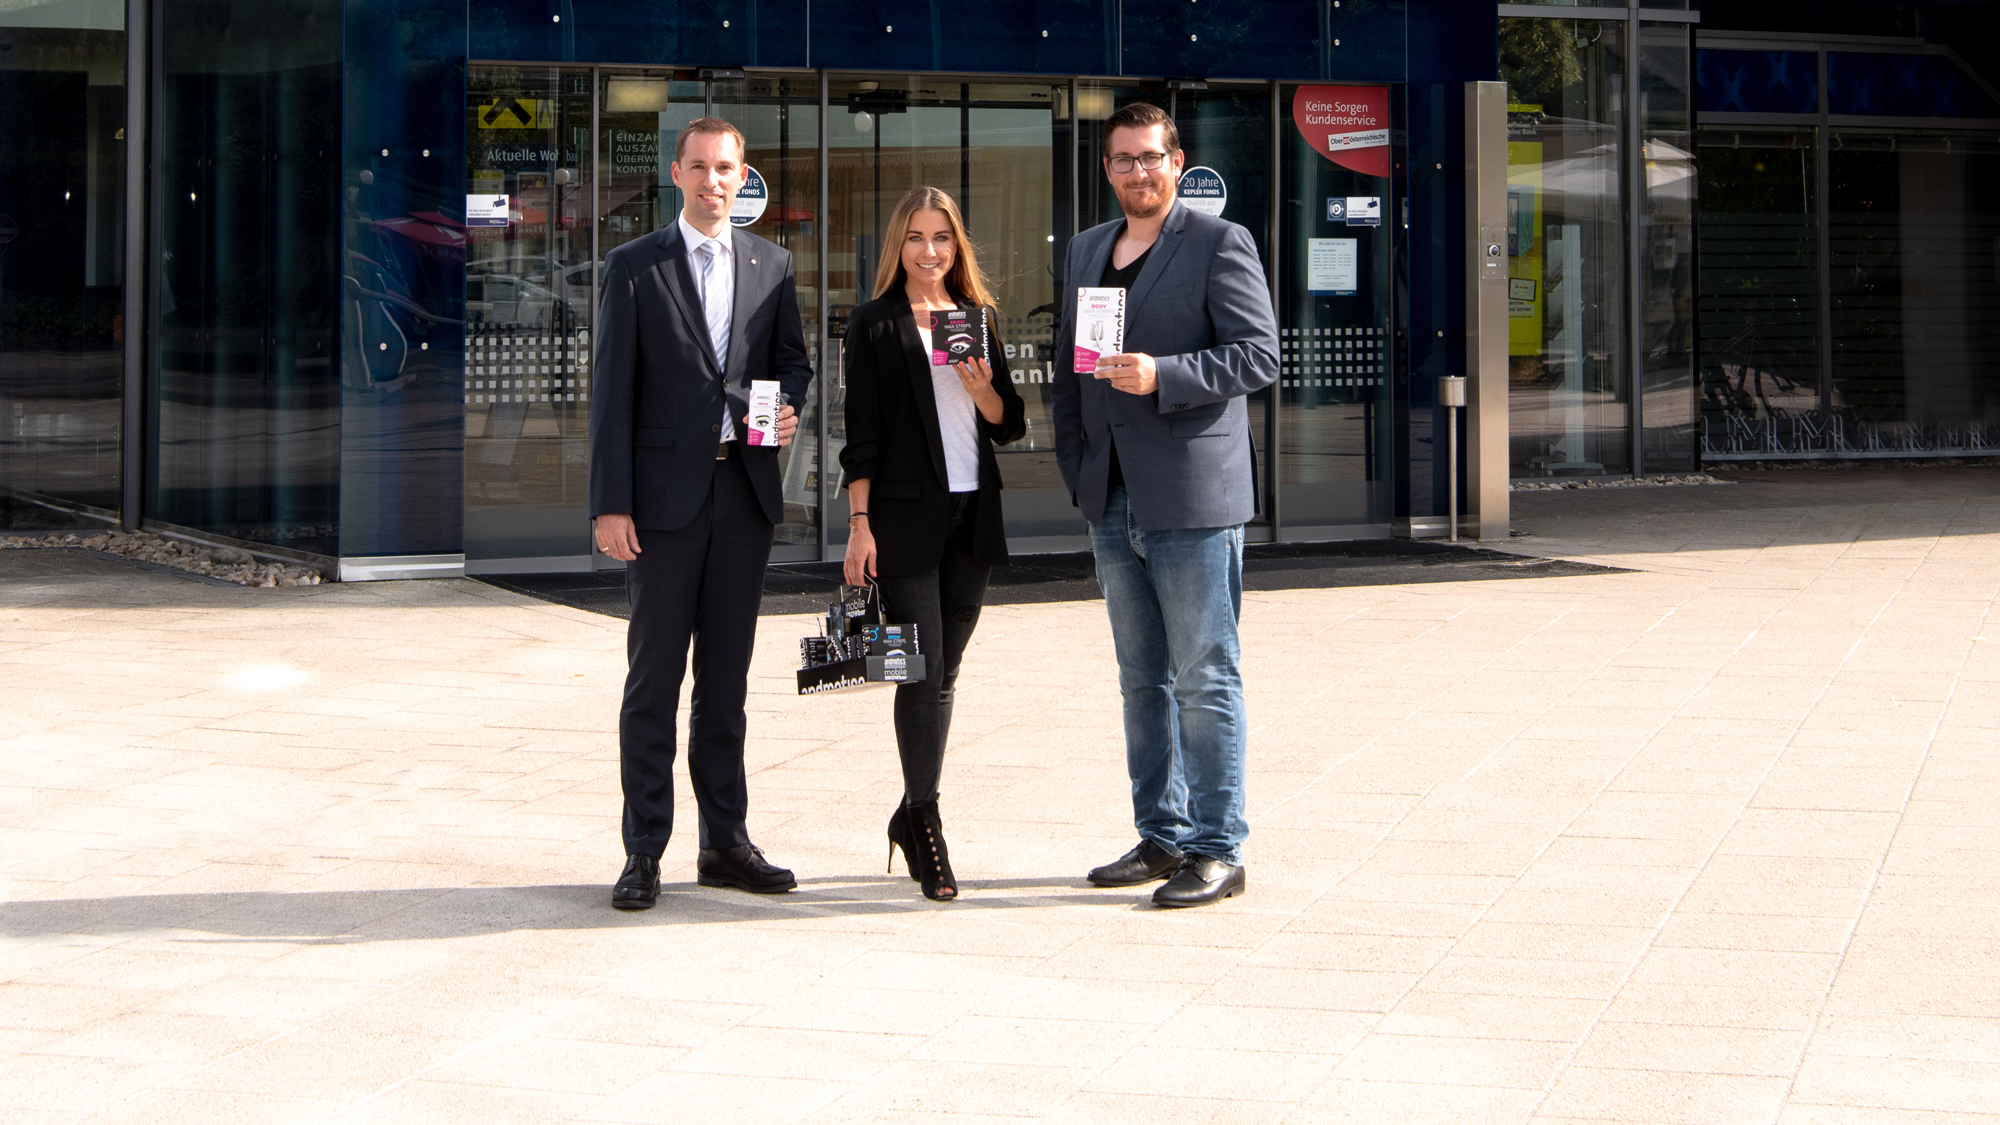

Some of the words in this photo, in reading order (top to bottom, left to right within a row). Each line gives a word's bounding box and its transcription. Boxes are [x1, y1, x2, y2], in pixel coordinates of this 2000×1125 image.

[1305, 101, 1333, 112] Keine
[1334, 101, 1368, 116] Sorgen
[1305, 113, 1377, 126] Kundenservice
[487, 148, 537, 162] Aktuelle
[1184, 177, 1195, 188] 20
[1197, 176, 1219, 190] Jahre
[741, 188, 760, 196] FONDS
[732, 208, 753, 216] fahrung
[1004, 343, 1034, 359] en
[884, 668, 908, 676] mobile
